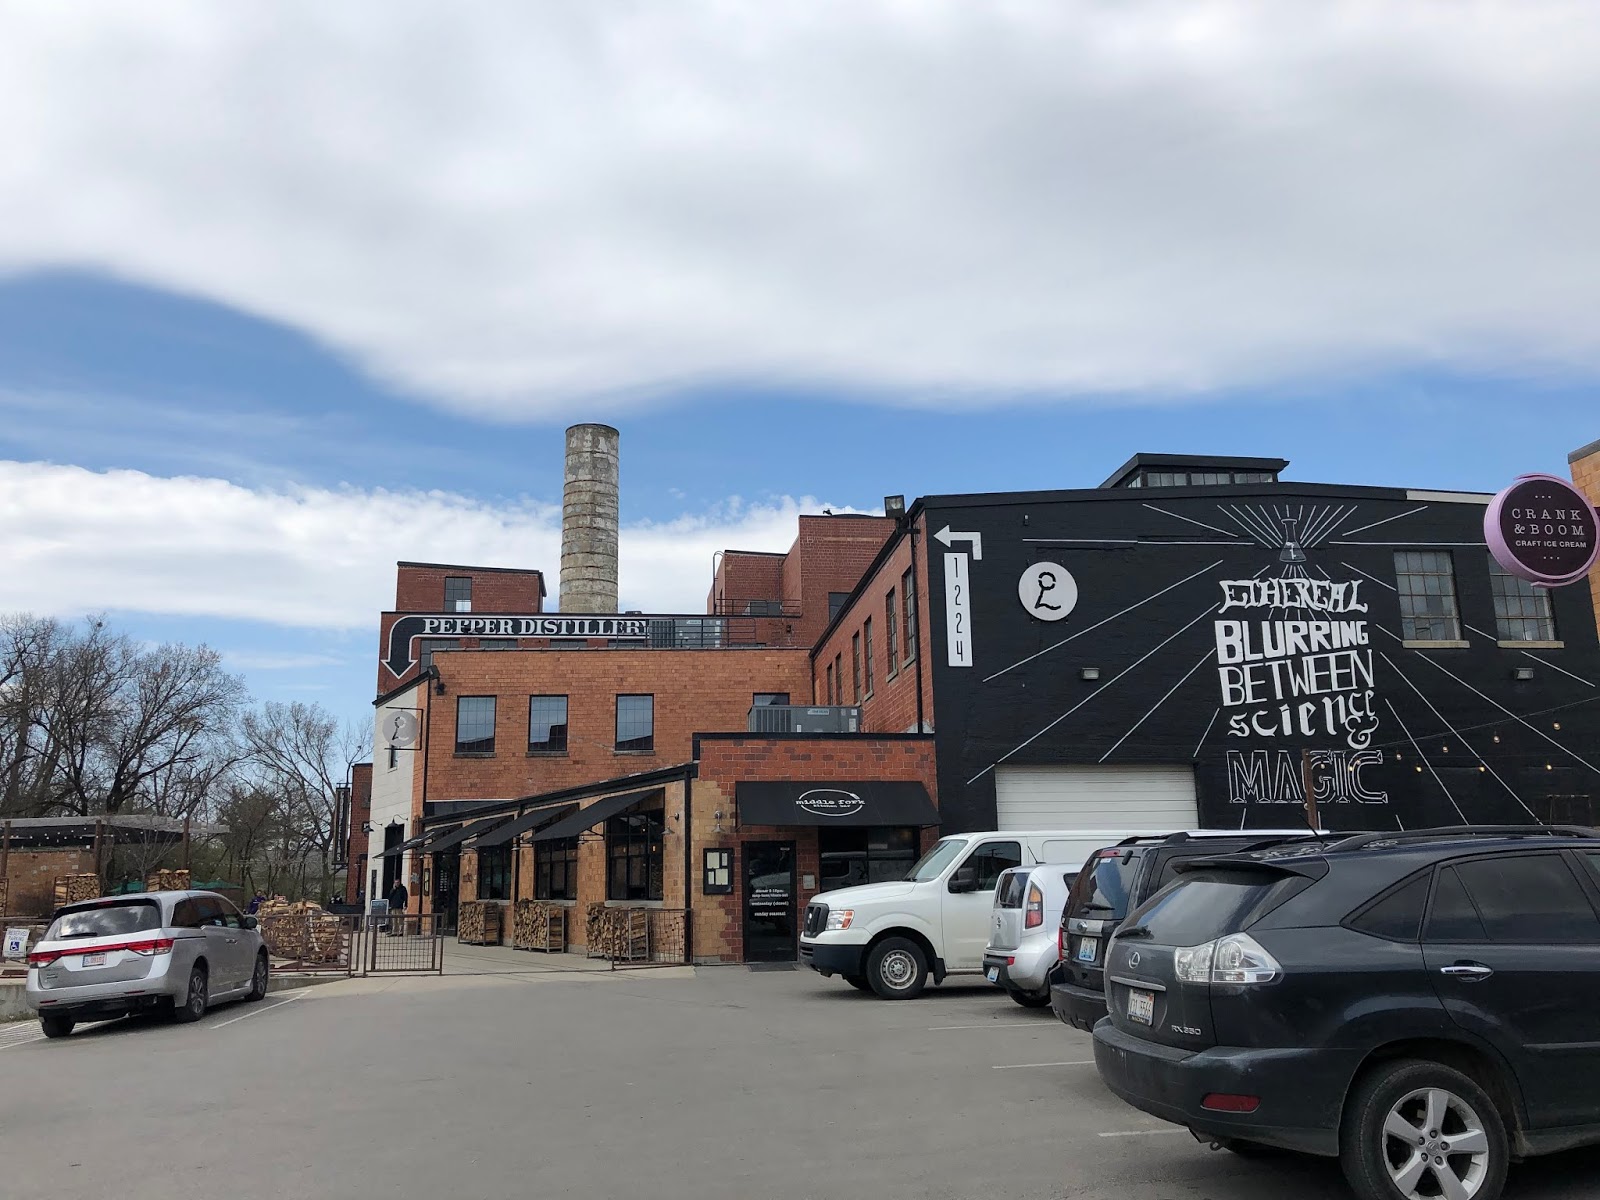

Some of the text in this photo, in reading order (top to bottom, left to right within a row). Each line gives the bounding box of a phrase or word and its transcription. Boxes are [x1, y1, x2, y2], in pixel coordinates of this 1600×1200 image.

[1511, 508, 1582, 521] CRANK
[1514, 523, 1585, 536] & BOOM
[953, 557, 963, 662] 1224
[1218, 577, 1369, 614] ETHEREAL
[422, 618, 514, 635] PEPPER
[1214, 620, 1369, 665] BLURRING
[1217, 649, 1375, 707] BETWEEN
[1344, 715, 1380, 750] &
[1226, 750, 1389, 804] MAGIC
